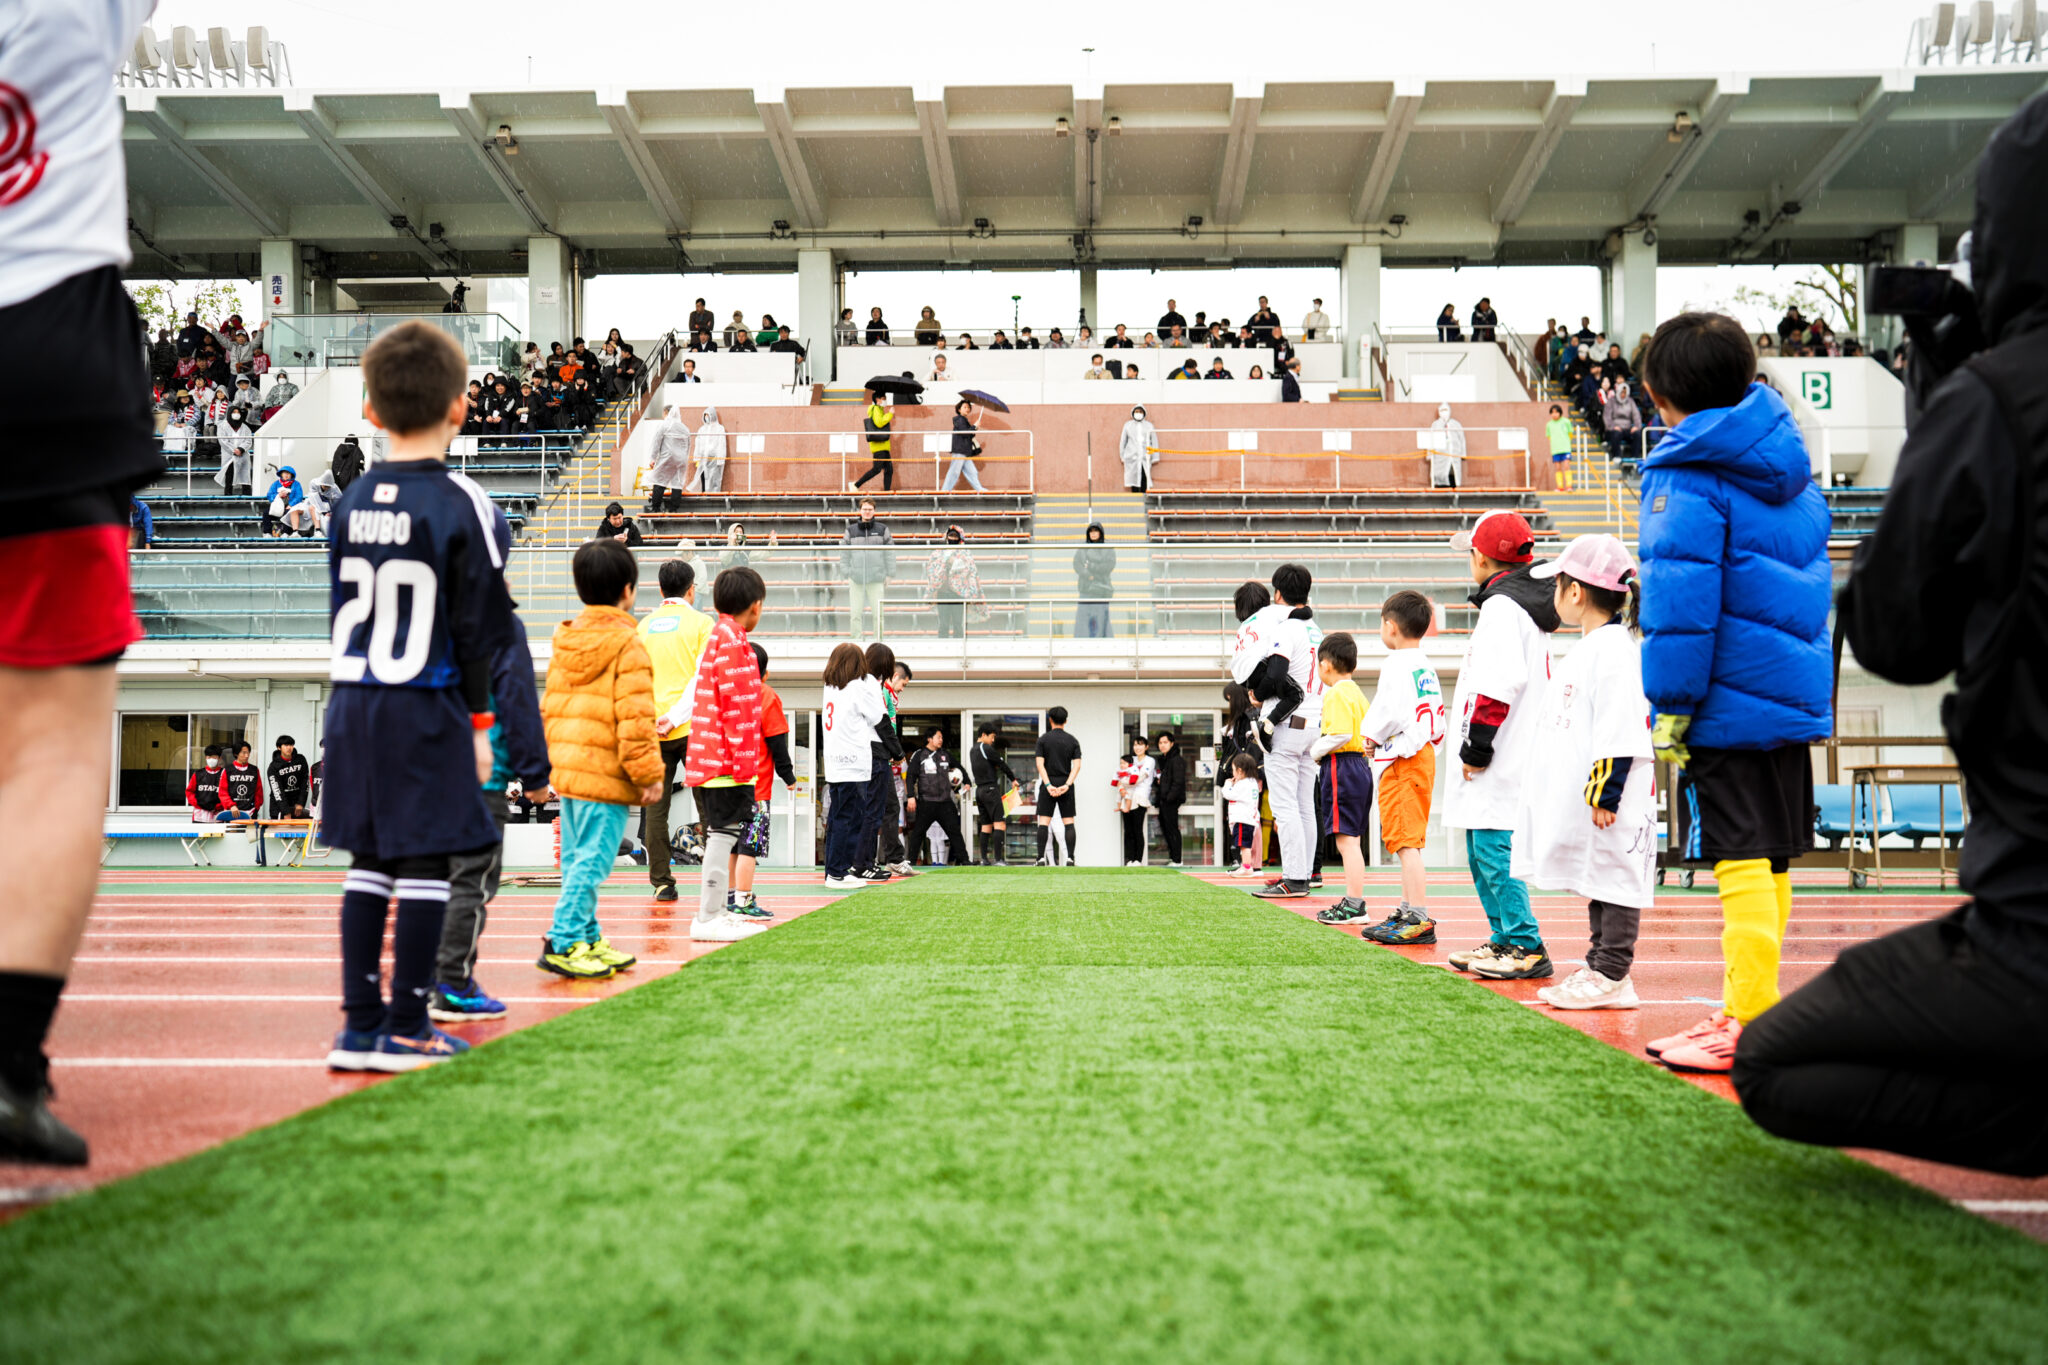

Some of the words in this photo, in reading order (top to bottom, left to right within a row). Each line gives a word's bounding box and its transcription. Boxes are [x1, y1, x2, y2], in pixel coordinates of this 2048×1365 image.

[271, 275, 283, 296] 売店
[1805, 372, 1829, 409] B
[348, 509, 412, 546] KUBO
[330, 556, 437, 685] 20
[825, 701, 835, 732] 3
[229, 774, 255, 782] STAFF
[279, 764, 302, 776] STAFF
